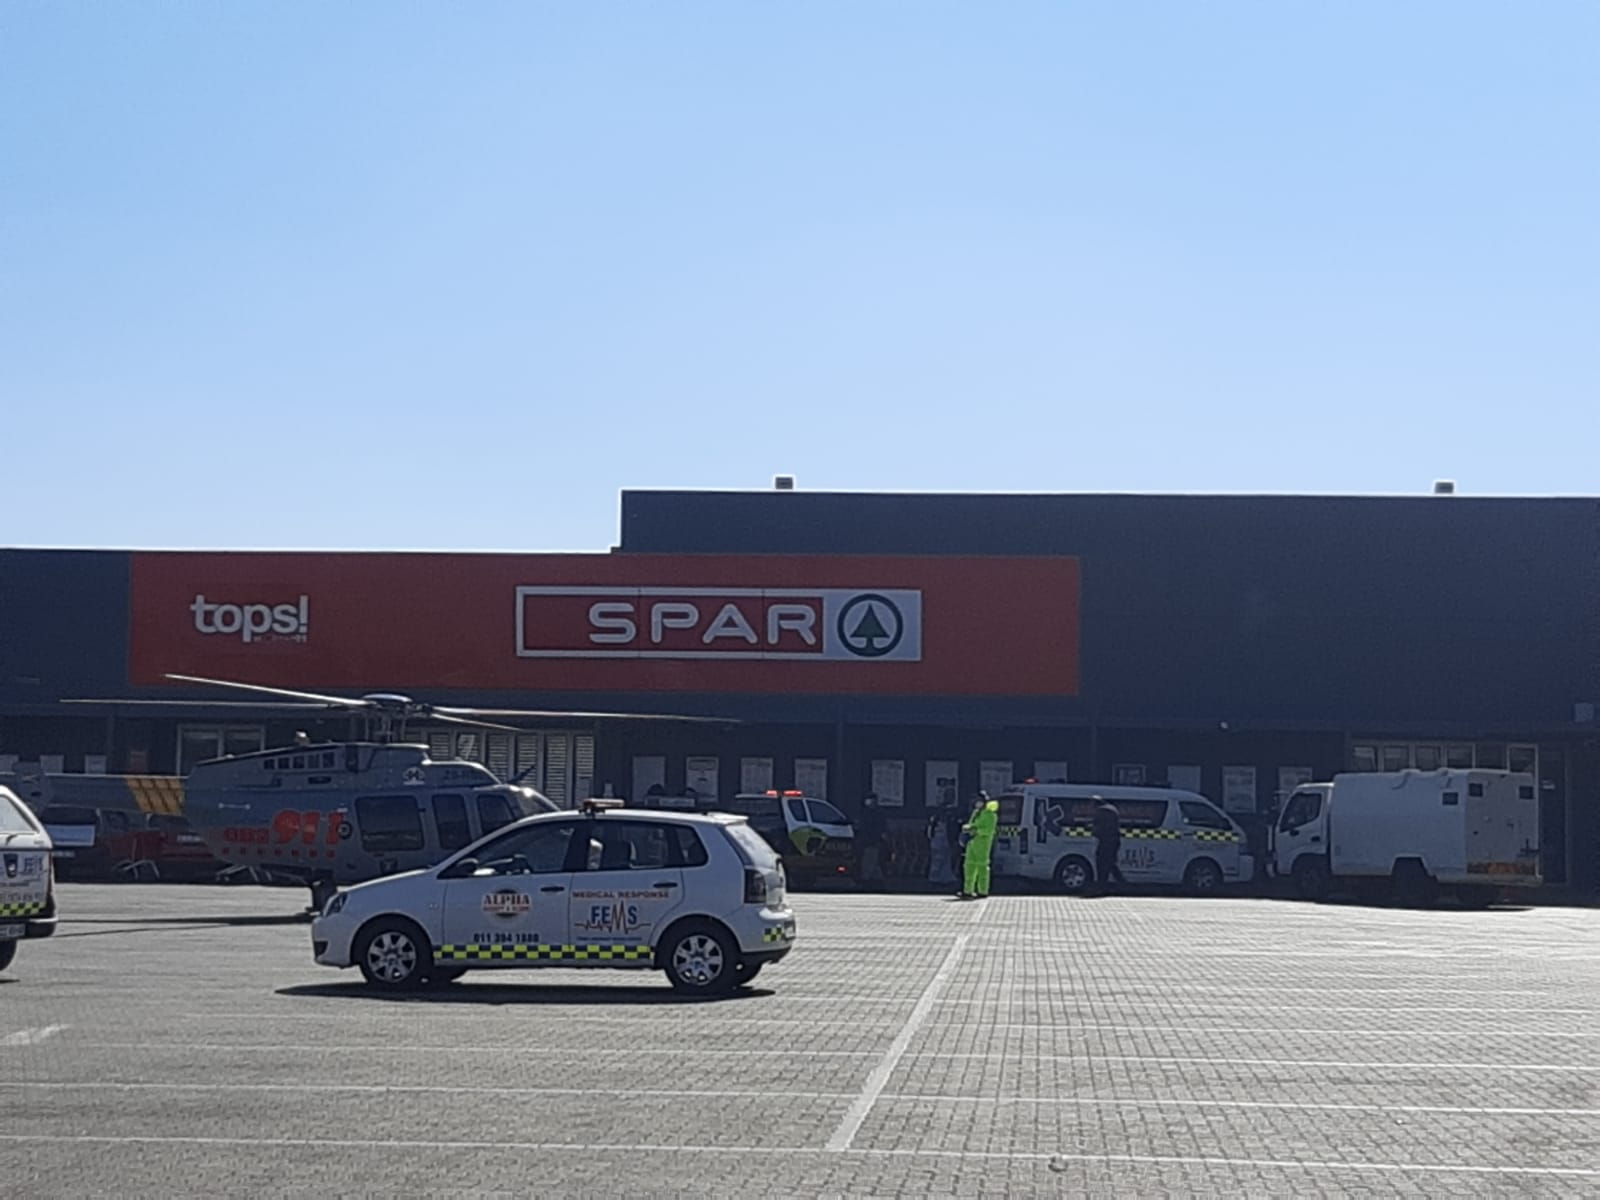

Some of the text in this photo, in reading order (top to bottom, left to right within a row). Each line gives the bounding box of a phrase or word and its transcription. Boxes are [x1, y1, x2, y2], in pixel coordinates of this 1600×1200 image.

[190, 594, 309, 643] tops!
[588, 602, 817, 645] SPAR
[483, 894, 530, 905] ALPHA
[572, 890, 669, 898] MEDICAL RESPONSE
